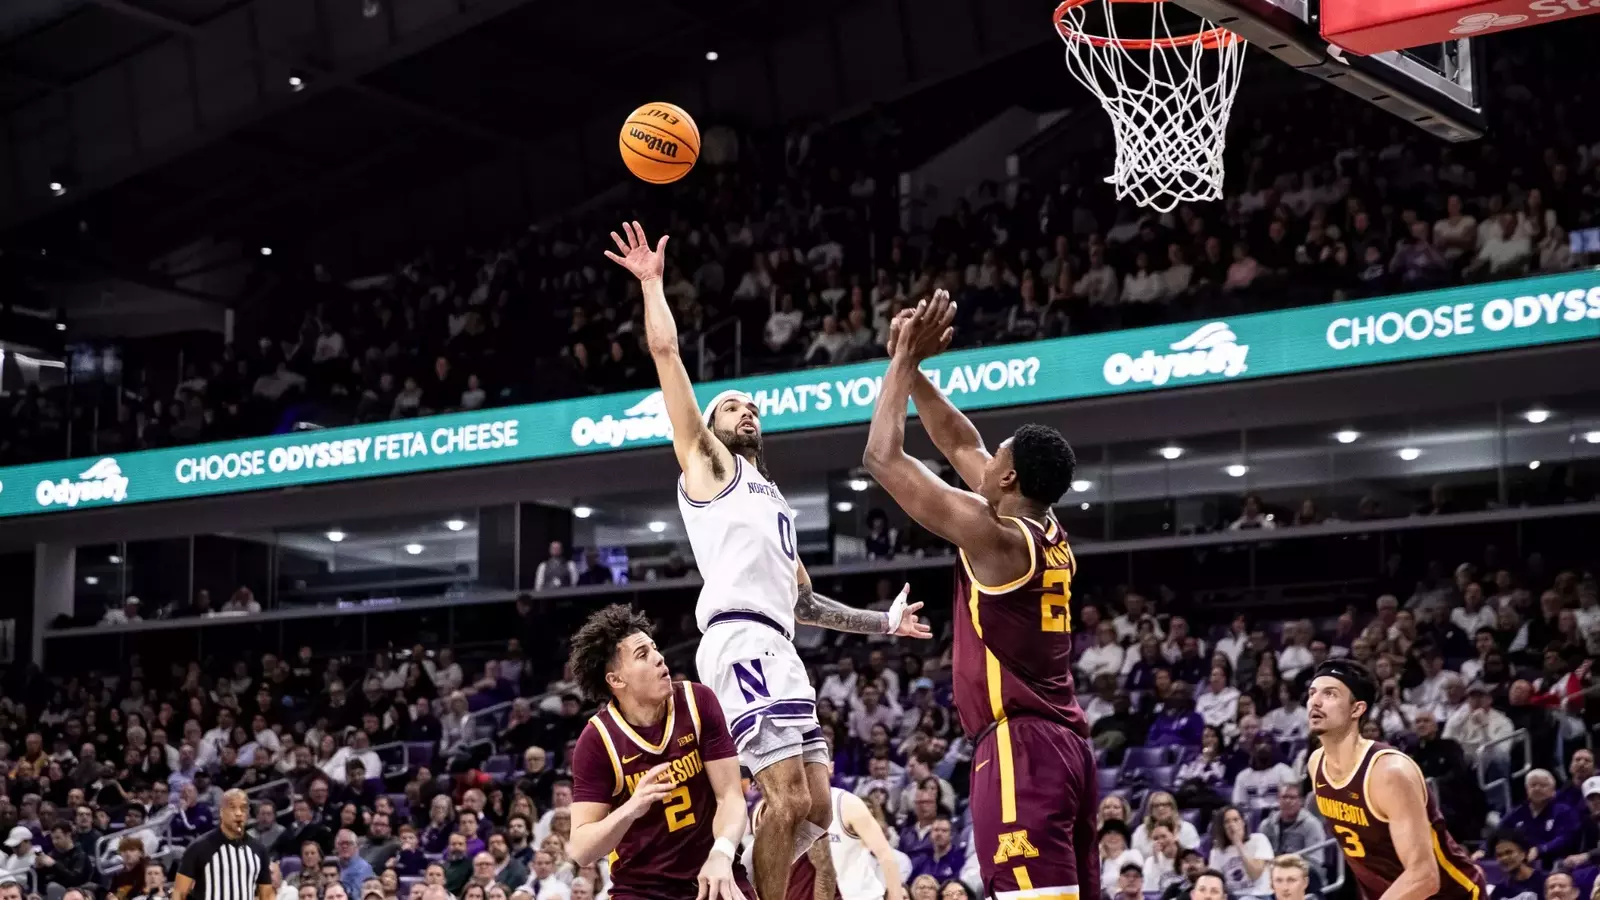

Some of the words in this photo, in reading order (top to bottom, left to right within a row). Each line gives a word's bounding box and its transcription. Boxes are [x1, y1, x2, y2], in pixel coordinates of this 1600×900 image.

[1529, 0, 1600, 17] St
[630, 127, 679, 158] Wilson
[1326, 303, 1475, 350] CHOOSE
[1103, 342, 1249, 386] Odyssey
[175, 449, 265, 483] CHOOSE
[268, 437, 372, 473] ODYSSEY
[374, 431, 428, 461] FETA
[430, 419, 519, 455] CHEESE
[36, 476, 129, 507] Odyssey
[747, 482, 779, 499] NORTH
[777, 512, 795, 561] 0
[1041, 569, 1071, 633] 2
[732, 658, 771, 704] N
[662, 785, 696, 833] 2
[1316, 795, 1370, 827] MINNESOTA
[993, 829, 1040, 865] M
[1333, 825, 1366, 858] 3
